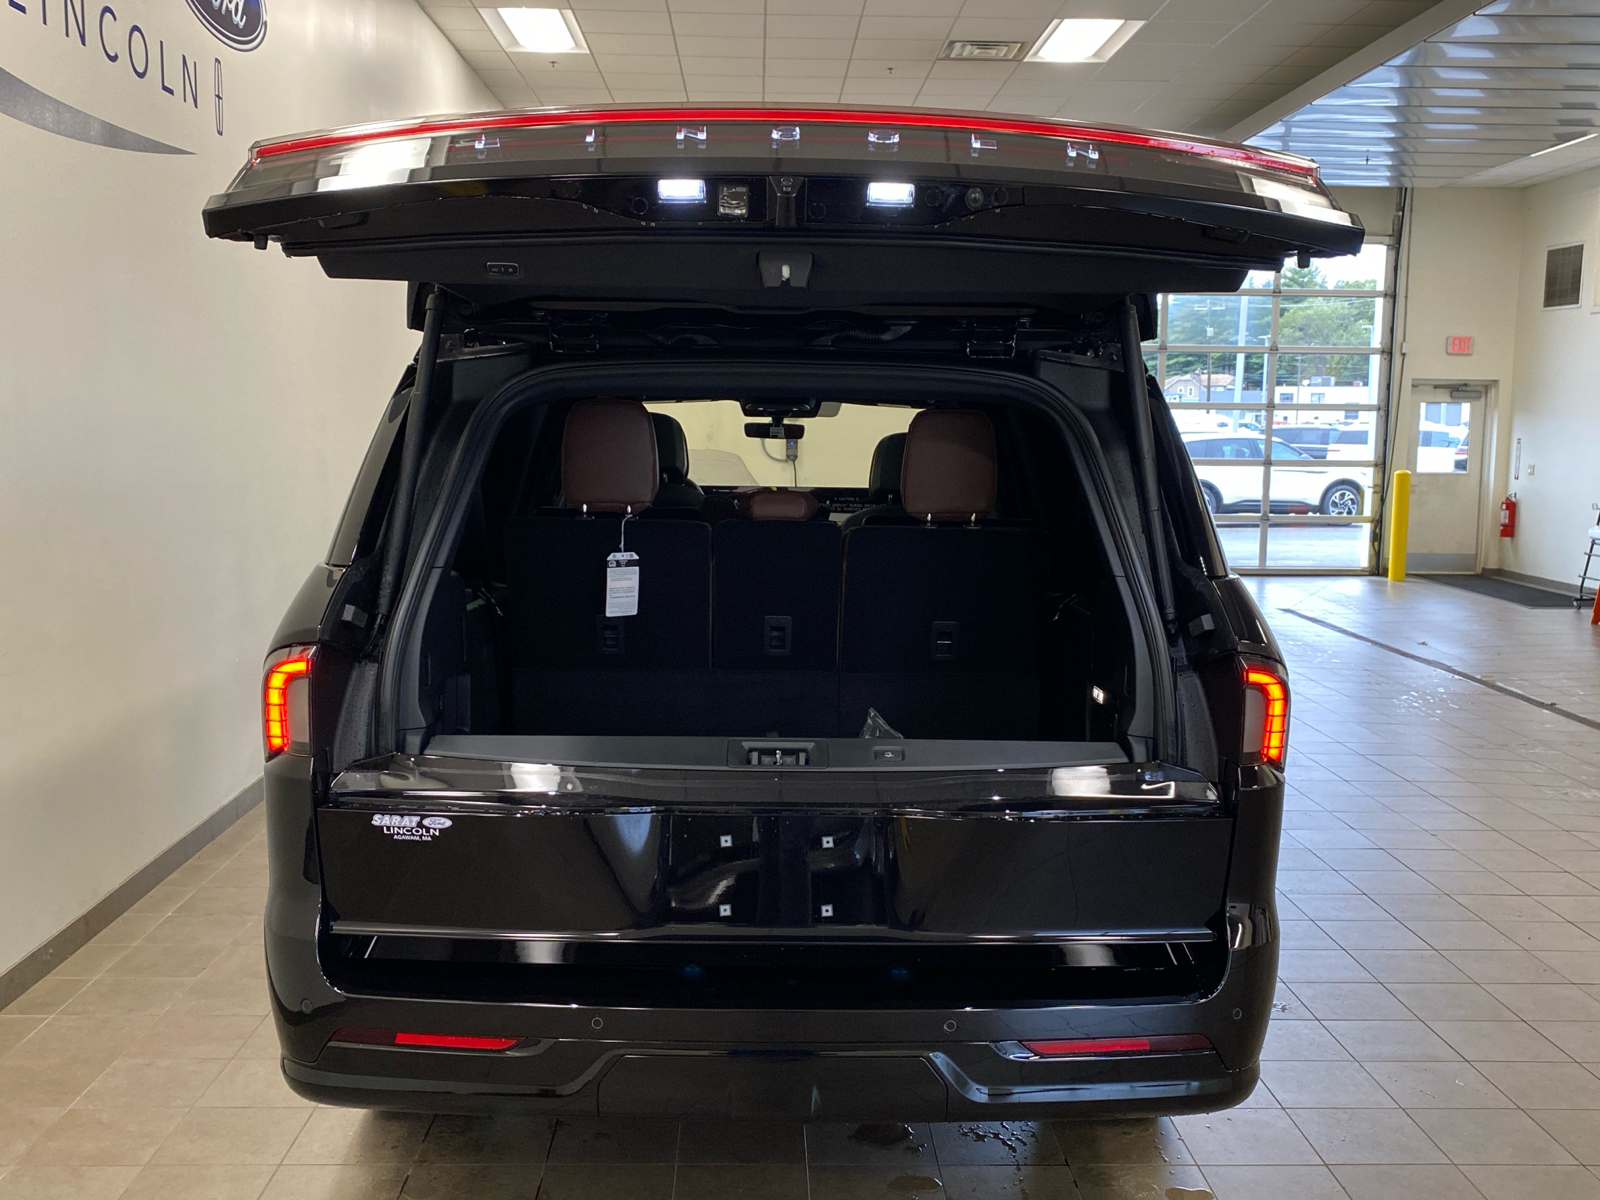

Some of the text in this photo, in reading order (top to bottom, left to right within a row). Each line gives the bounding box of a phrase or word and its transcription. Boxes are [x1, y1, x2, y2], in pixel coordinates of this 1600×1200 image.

[8, 0, 198, 109] NCOLN
[1451, 336, 1472, 353] EXIT
[371, 814, 448, 827] SARAT Ford
[383, 826, 439, 836] LINCOLN
